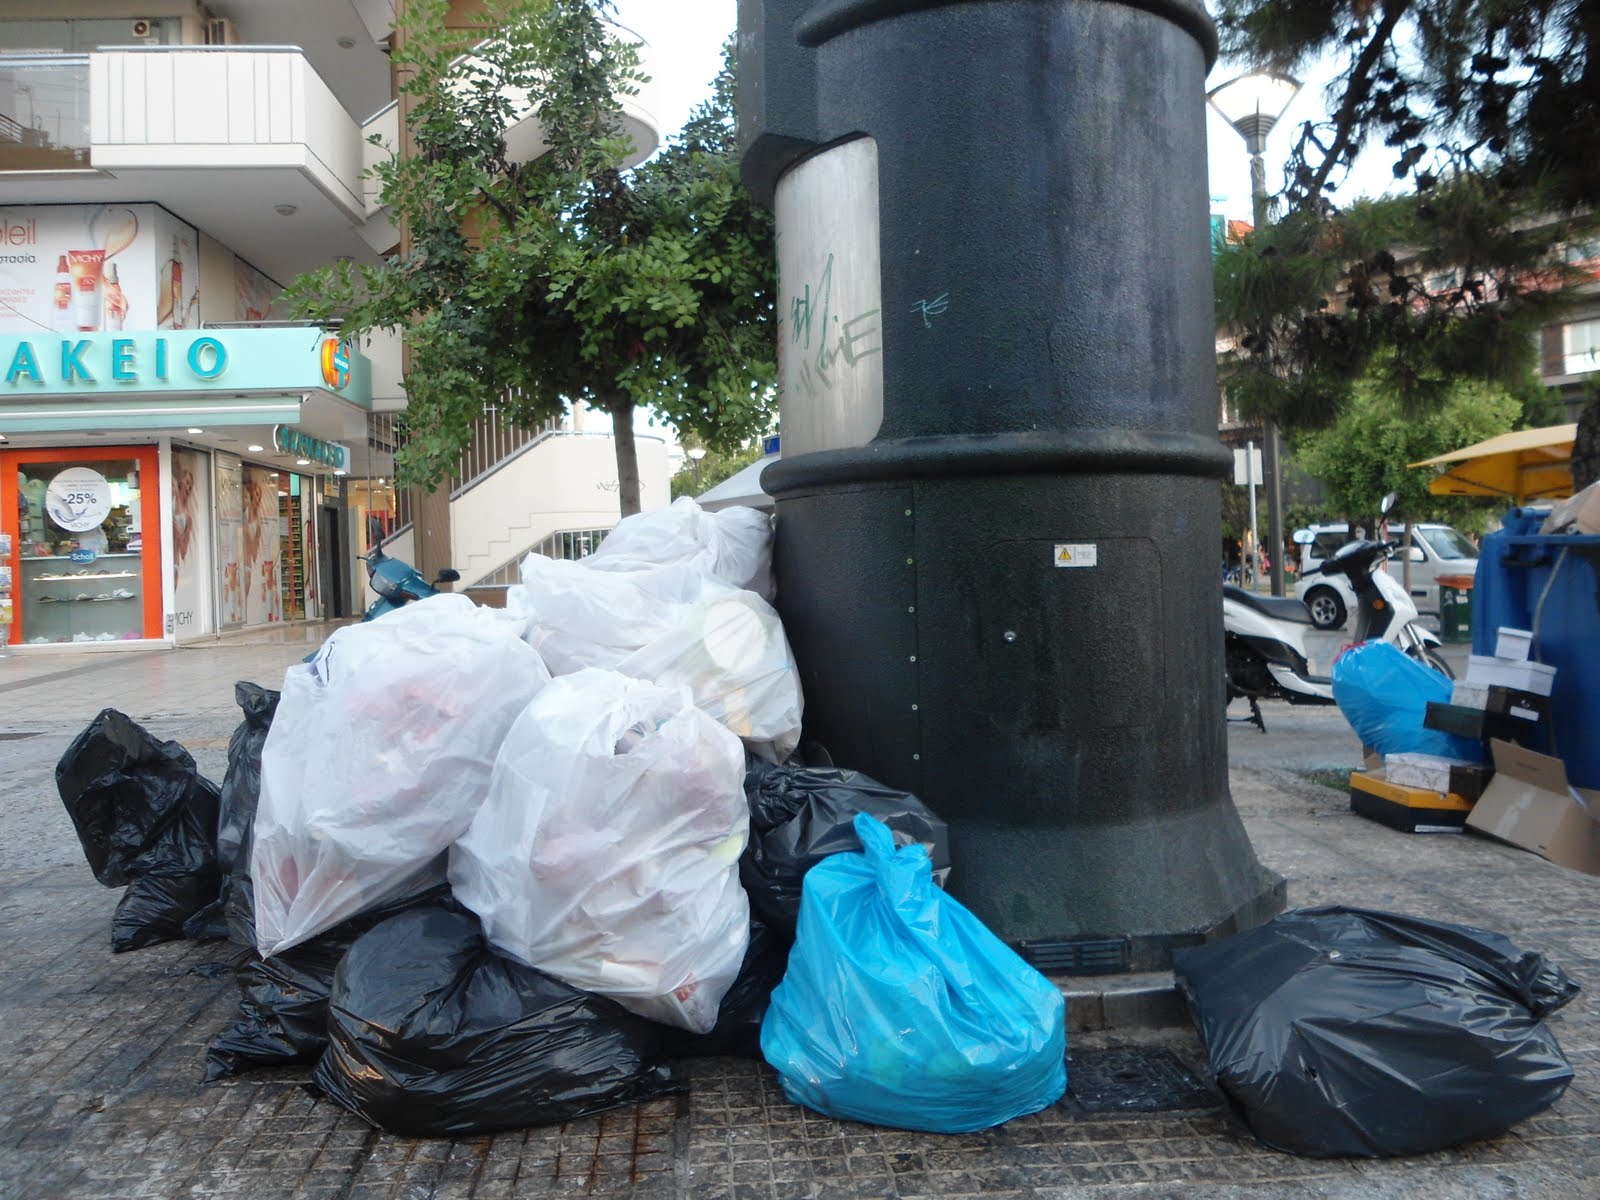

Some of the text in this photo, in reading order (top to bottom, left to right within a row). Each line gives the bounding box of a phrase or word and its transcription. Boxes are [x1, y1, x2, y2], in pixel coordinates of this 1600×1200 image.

[0, 219, 36, 246] leil
[68, 254, 103, 263] VICHY
[5, 336, 229, 385] ΑΚΕΙΟ
[62, 493, 97, 504] -25%
[72, 552, 95, 561] Scholl
